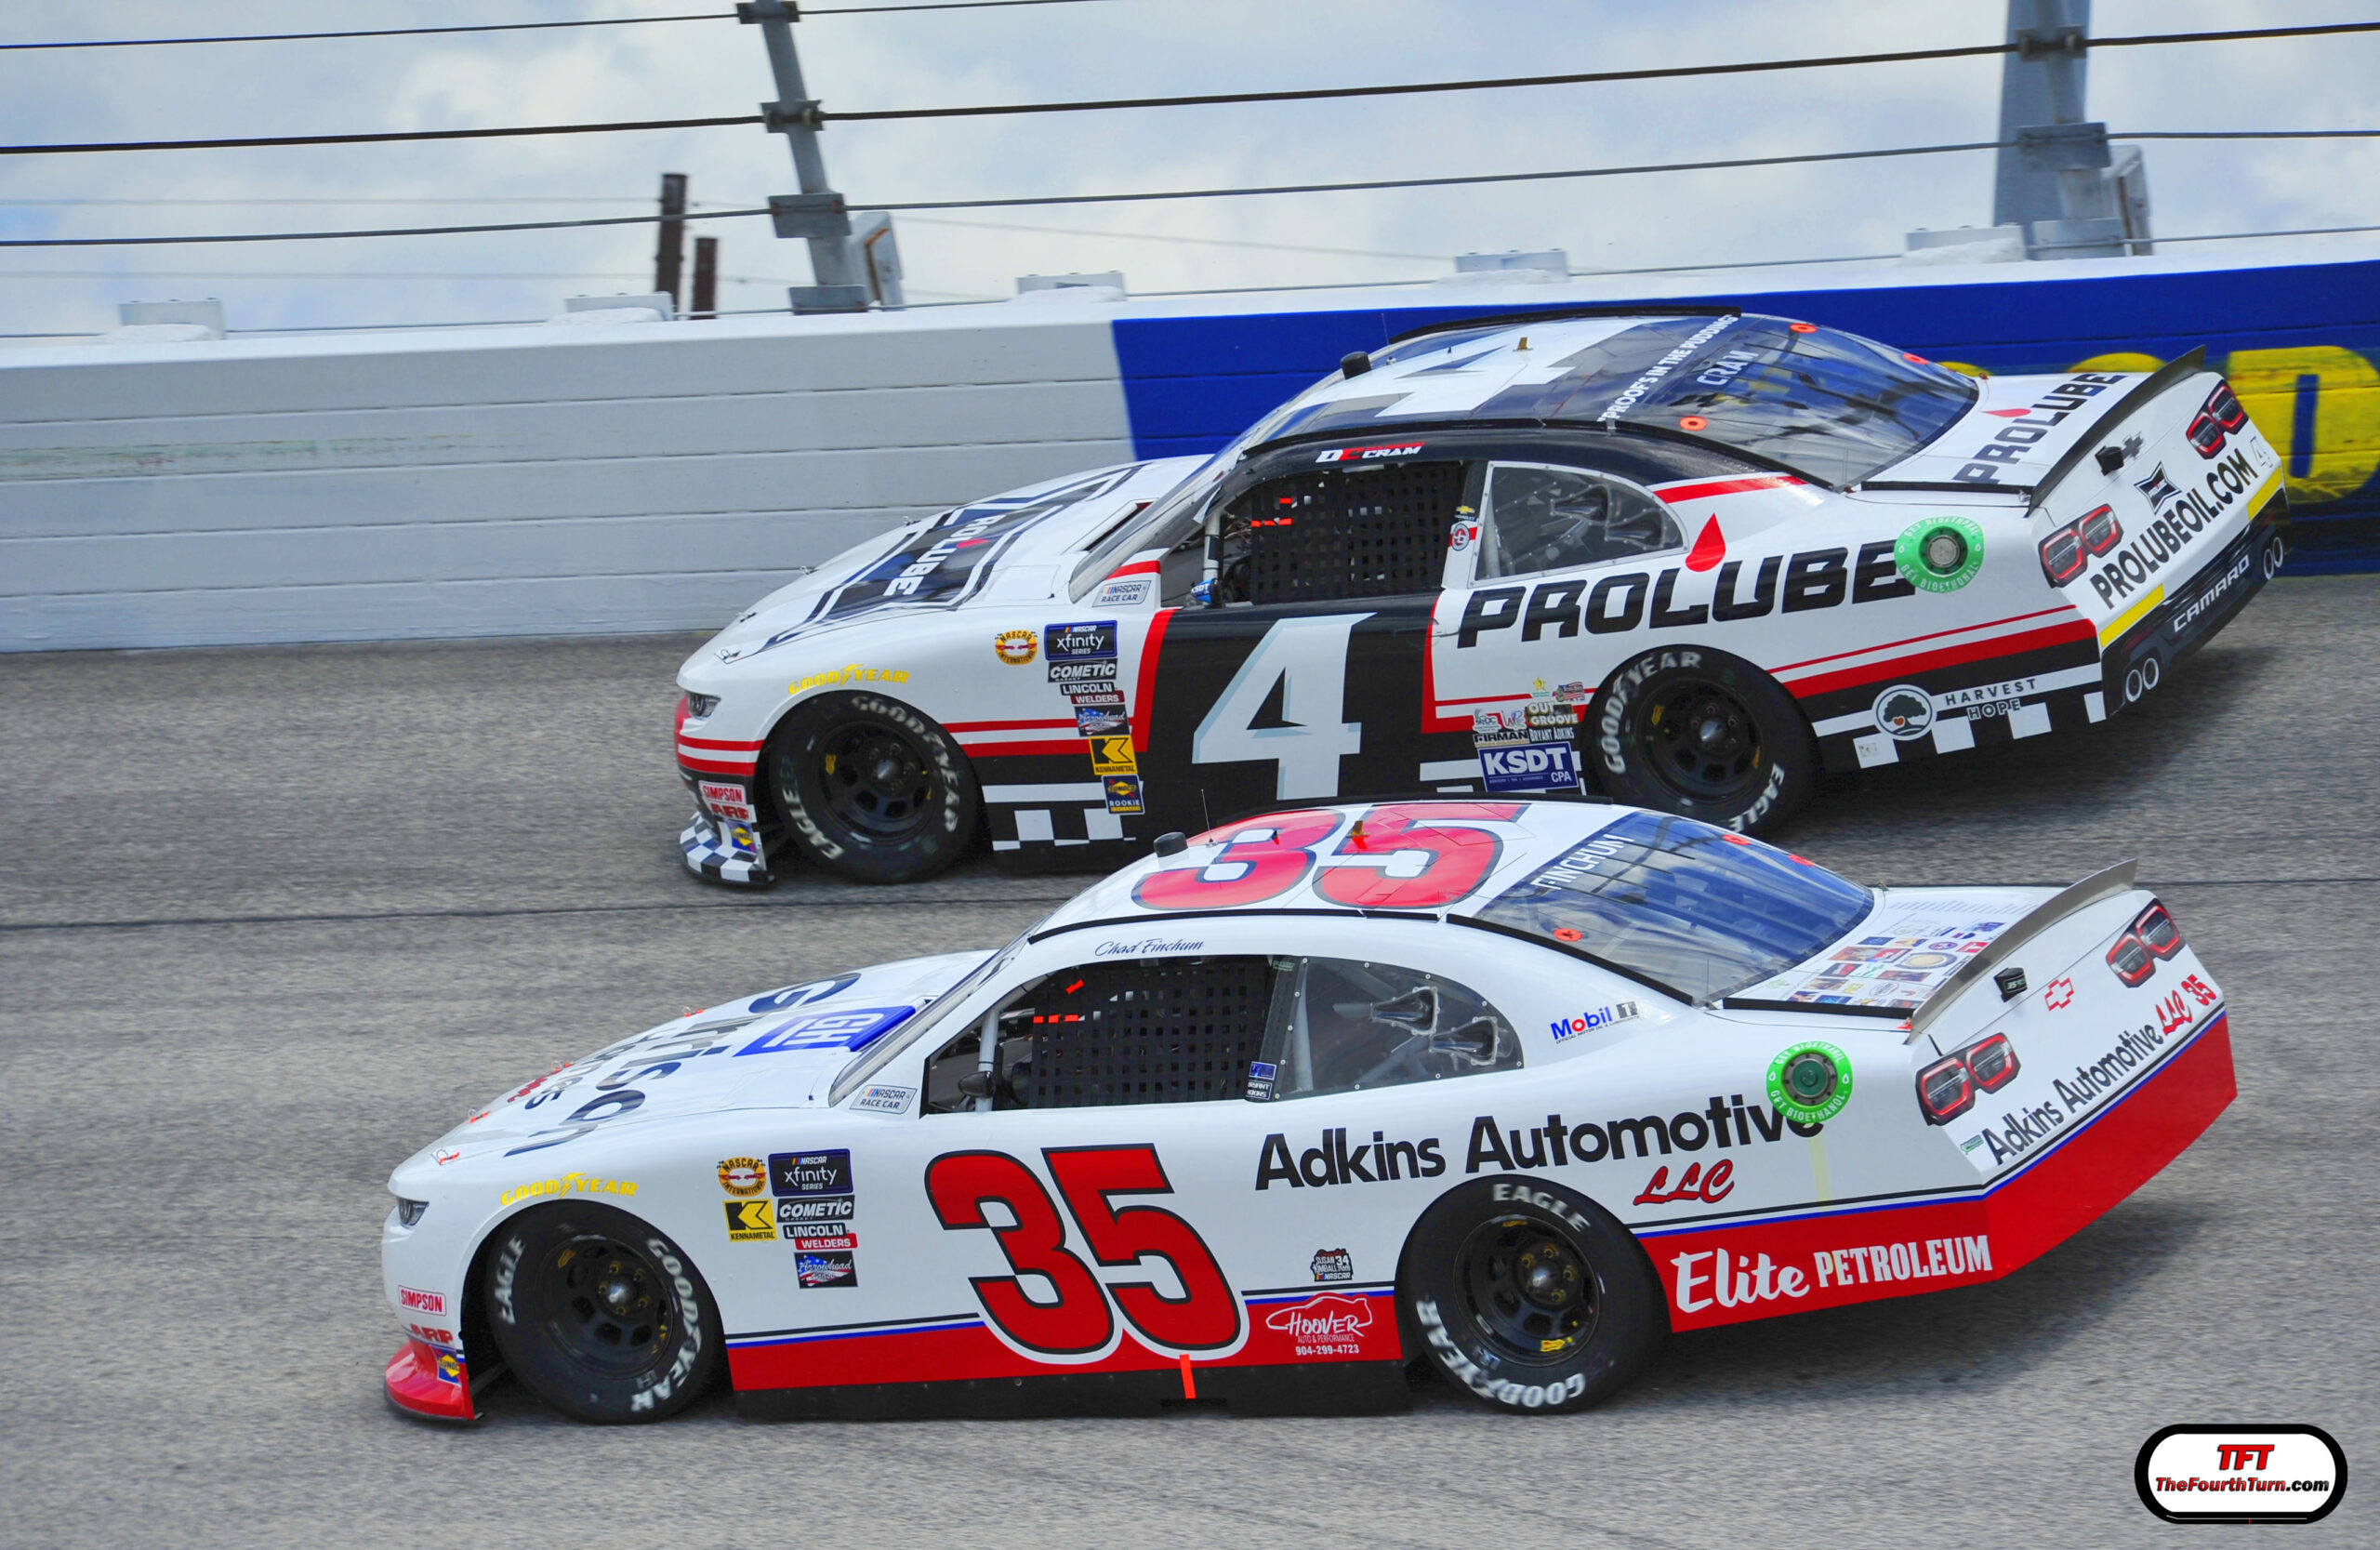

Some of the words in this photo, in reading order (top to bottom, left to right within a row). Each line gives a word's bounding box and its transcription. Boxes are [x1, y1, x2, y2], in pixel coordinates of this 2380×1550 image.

[1657, 348, 1692, 373] THE
[1697, 350, 1759, 386] CRAM
[1646, 366, 1669, 380] IN
[1951, 374, 2128, 484] PROLUBE
[1362, 445, 1422, 458] CRAM
[2089, 448, 2259, 610] PROLUBEOIL.COM
[883, 514, 1007, 596] ROLUBE
[1112, 584, 1143, 594] NASCAR
[1457, 539, 1916, 649] PROLUBE
[2174, 554, 2251, 632] CAMARO
[999, 630, 1033, 643] NASCAR
[1072, 625, 1098, 633] NASCAR
[1056, 633, 1104, 652] xfinity
[787, 663, 910, 695] GOODYEAR
[1050, 660, 1117, 680] COMETIC
[1062, 683, 1114, 696] LINCOLN
[1076, 695, 1119, 704] WELDERS
[1944, 679, 2038, 707] HARVEST
[1191, 612, 1379, 801] 4
[1527, 702, 1555, 715] OUT
[1601, 652, 1702, 775] GOODYEAR
[1966, 698, 2022, 721] HOPE
[1530, 713, 1580, 726] GROOVE
[1529, 728, 1553, 742] BRYANT
[1095, 764, 1136, 774] KENNAMETAL
[1484, 747, 1567, 775] KSDT
[1551, 771, 1573, 783] CPA
[702, 785, 743, 802] SIMPSON
[1727, 762, 1785, 832] EAGLE
[782, 788, 844, 860] EAGLE
[1130, 801, 1532, 910] 35
[1530, 833, 1635, 890] FINCHUM
[1094, 939, 1144, 957] Chad
[1141, 937, 1205, 954] Finchum
[2181, 974, 2217, 1005] 35
[1550, 1006, 1612, 1040] Mobil
[1981, 1101, 2065, 1165] Adkins
[2053, 1022, 2164, 1113] Automotive
[2154, 989, 2194, 1036] LLC
[859, 1099, 880, 1107] RACE
[875, 1088, 906, 1100] NASCAR
[1770, 1090, 1787, 1109] GET
[723, 1158, 760, 1172] NASCAR
[800, 1156, 827, 1164] NASCAR
[1255, 1128, 1446, 1191] Adkins
[784, 1166, 838, 1186] xfinity
[801, 1183, 824, 1191] SERIES
[1633, 1159, 1735, 1206] LLC
[500, 1172, 638, 1206] GOODYEAR
[779, 1200, 853, 1218] COMETIC
[1492, 1184, 1591, 1233] EAGLE
[731, 1231, 775, 1240] KENNAMETAL
[786, 1225, 843, 1238] LINCOLN
[801, 1238, 852, 1249] WELDERS
[924, 1143, 1244, 1358] 35
[798, 1258, 853, 1273] Arrowhead
[1335, 1255, 1349, 1265] 34
[494, 1235, 526, 1325] EAGLE
[1670, 1247, 1810, 1313] Elite
[1813, 1235, 1992, 1288] PETROLEUM
[401, 1289, 443, 1312] SIMPSON
[410, 1323, 453, 1345] ARP
[630, 1239, 702, 1413] GOODYEAR
[1286, 1309, 1365, 1338] HOOVER
[1298, 1335, 1312, 1344] AUTO
[1317, 1333, 1355, 1343] PERFORMANCE
[1295, 1345, 1359, 1356] 904-299-4723
[1416, 1299, 1587, 1409] GOODYEAR
